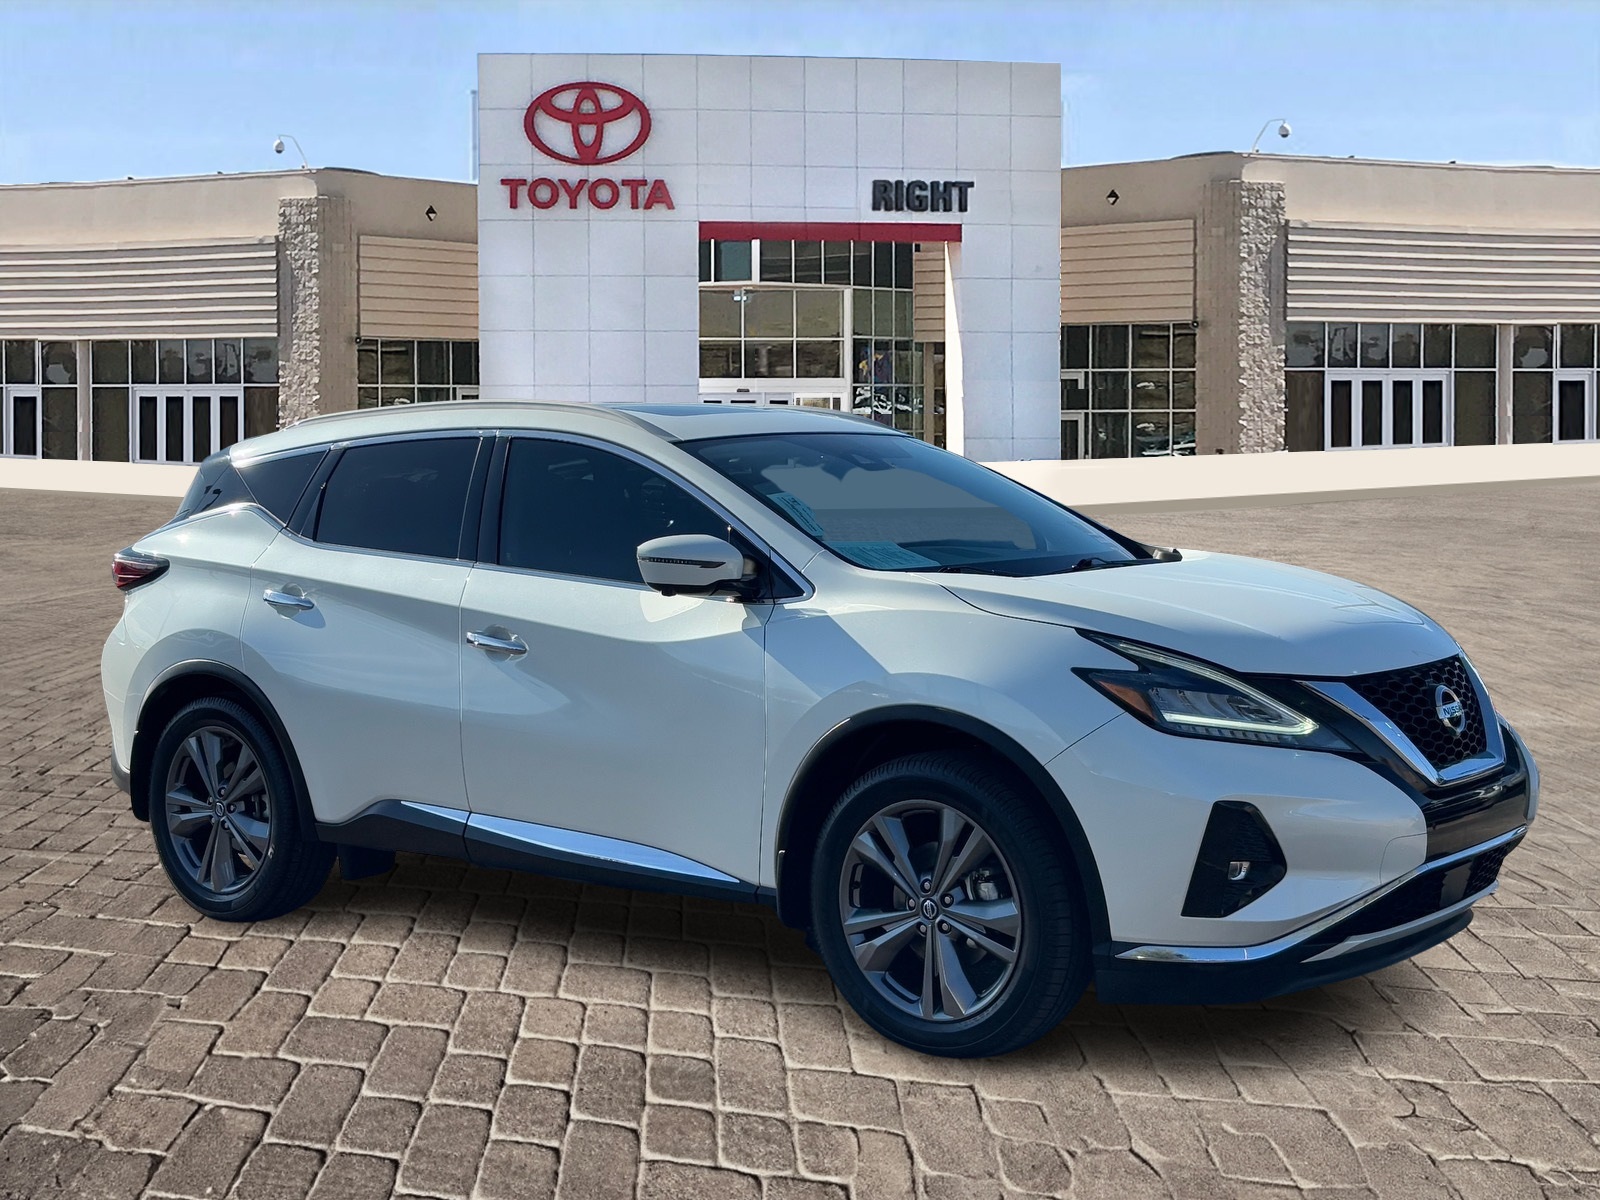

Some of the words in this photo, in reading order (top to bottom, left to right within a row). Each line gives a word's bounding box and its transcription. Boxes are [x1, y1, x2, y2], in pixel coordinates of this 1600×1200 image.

[500, 177, 676, 210] TOYOTA
[871, 179, 975, 212] RIGHT
[1442, 703, 1463, 717] NISS
